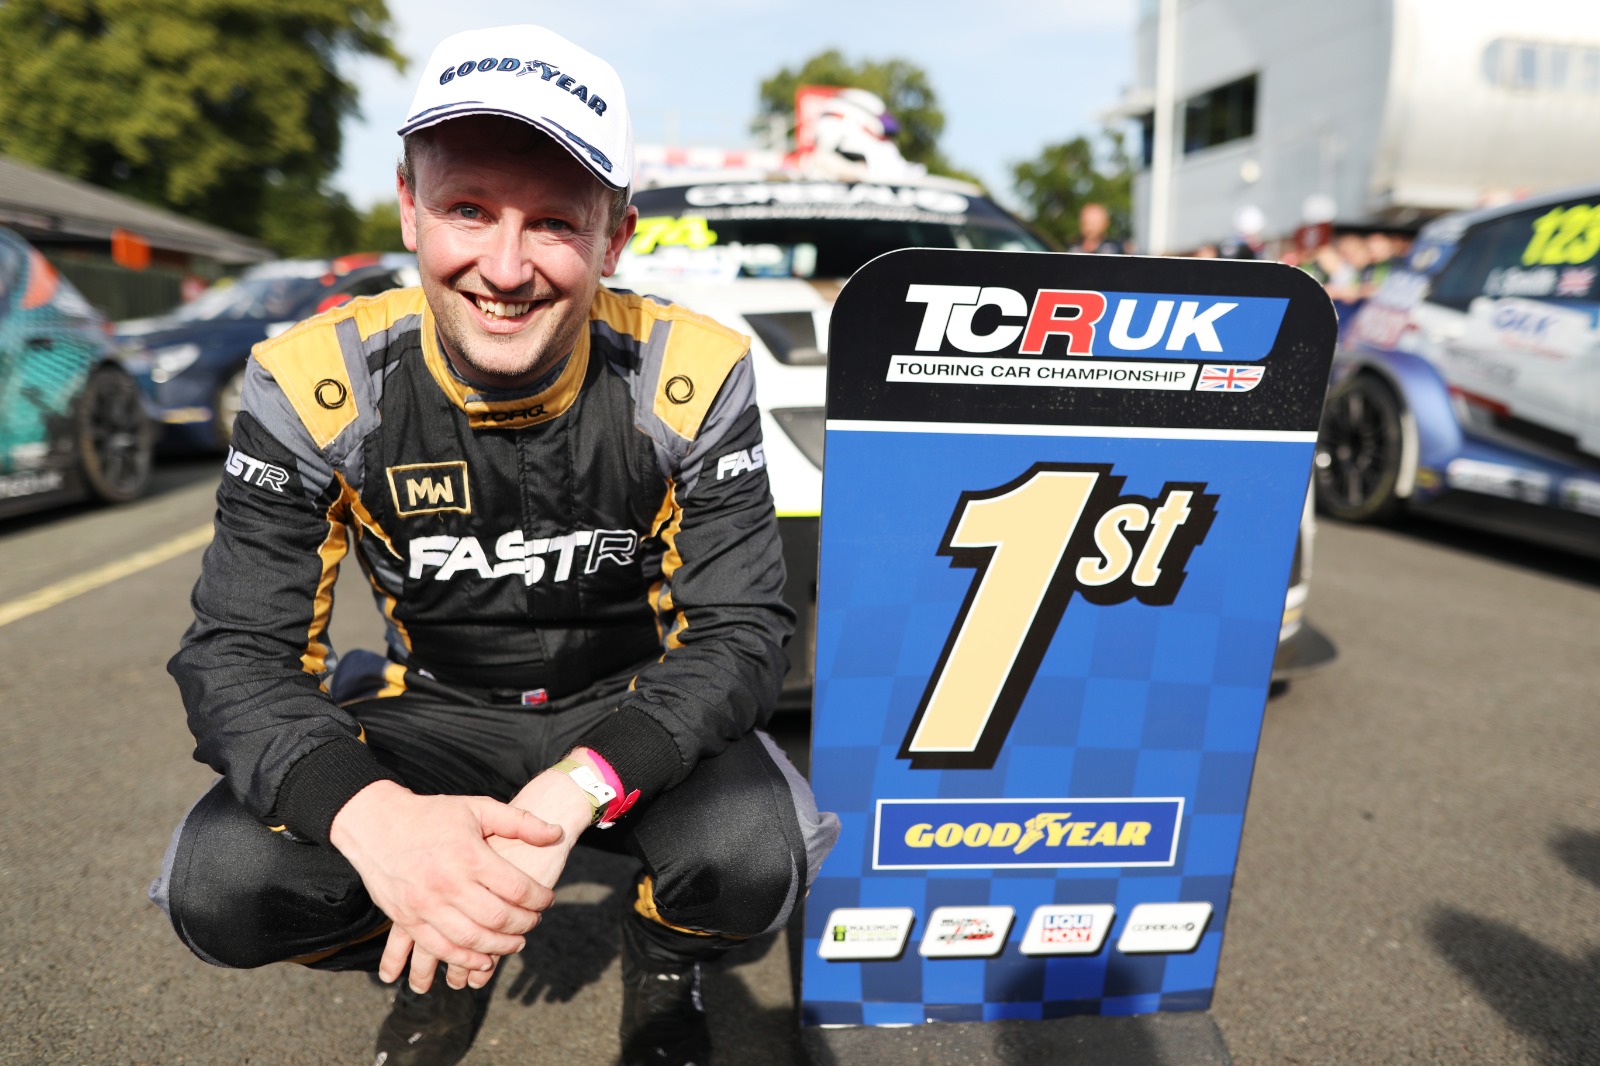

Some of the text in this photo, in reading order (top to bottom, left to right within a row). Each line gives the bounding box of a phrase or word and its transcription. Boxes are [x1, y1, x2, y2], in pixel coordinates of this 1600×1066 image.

[439, 56, 608, 117] GOODYEAR
[905, 284, 1239, 356] TCR UK
[896, 362, 1186, 383] TOURING CAR CHAMPIONSHIP
[406, 475, 455, 507] MW
[904, 815, 1152, 851] GOODYEAR
[1041, 928, 1091, 943] MOLY
[1043, 914, 1093, 929] LIQUI
